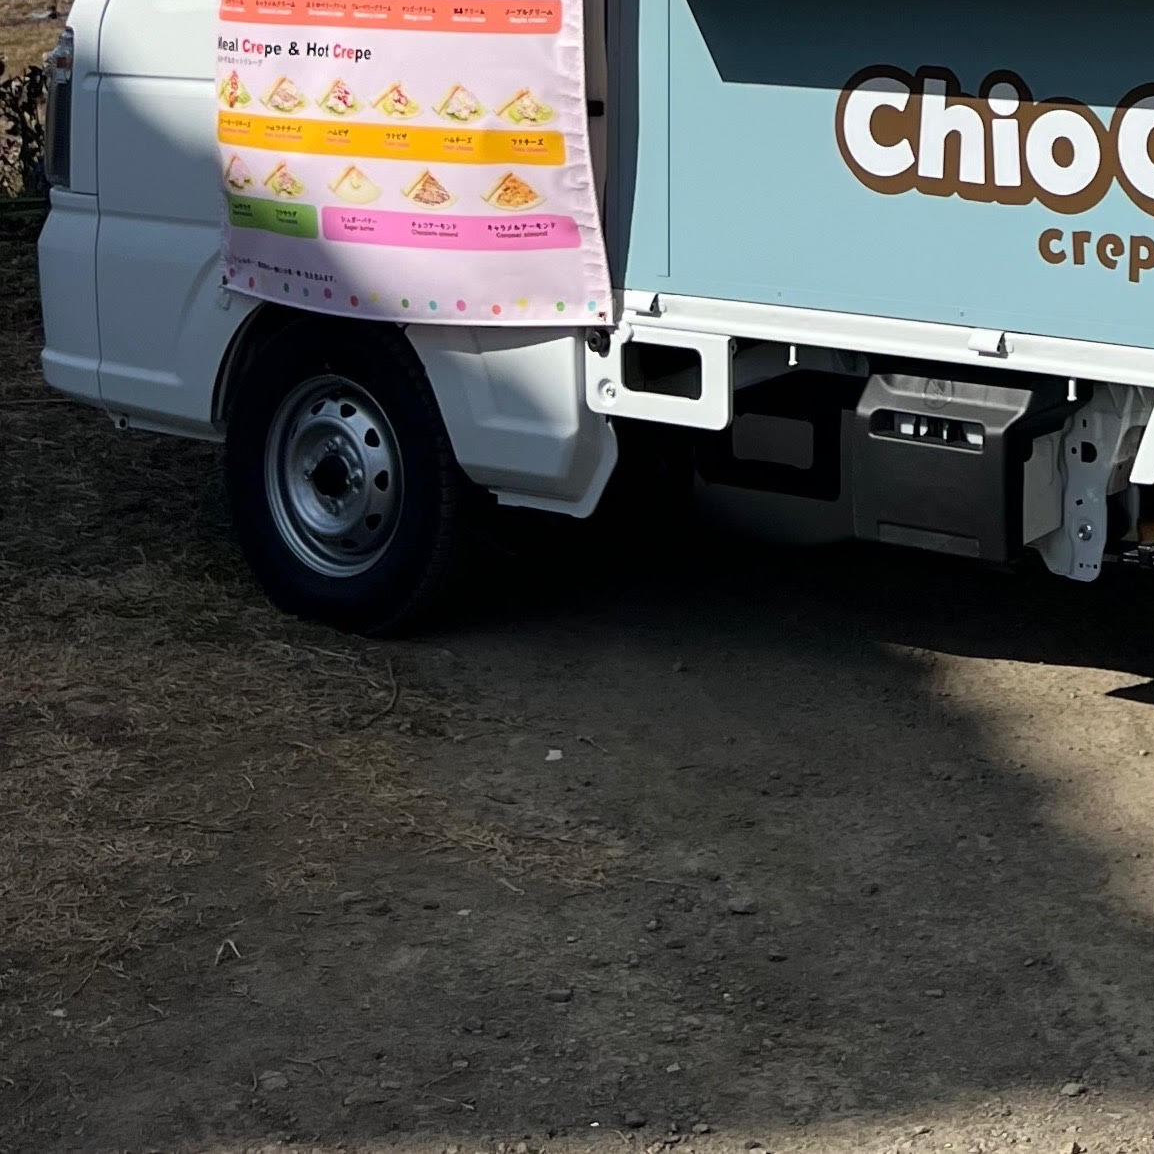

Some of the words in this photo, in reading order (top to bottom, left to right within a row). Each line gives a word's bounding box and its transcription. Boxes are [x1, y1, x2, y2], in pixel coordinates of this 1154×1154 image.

[242, 39, 282, 58] Crepe
[288, 41, 300, 56] &
[306, 42, 329, 57] Hot
[333, 43, 372, 63] Crepe
[487, 221, 556, 231] キャラメルアーモンド
